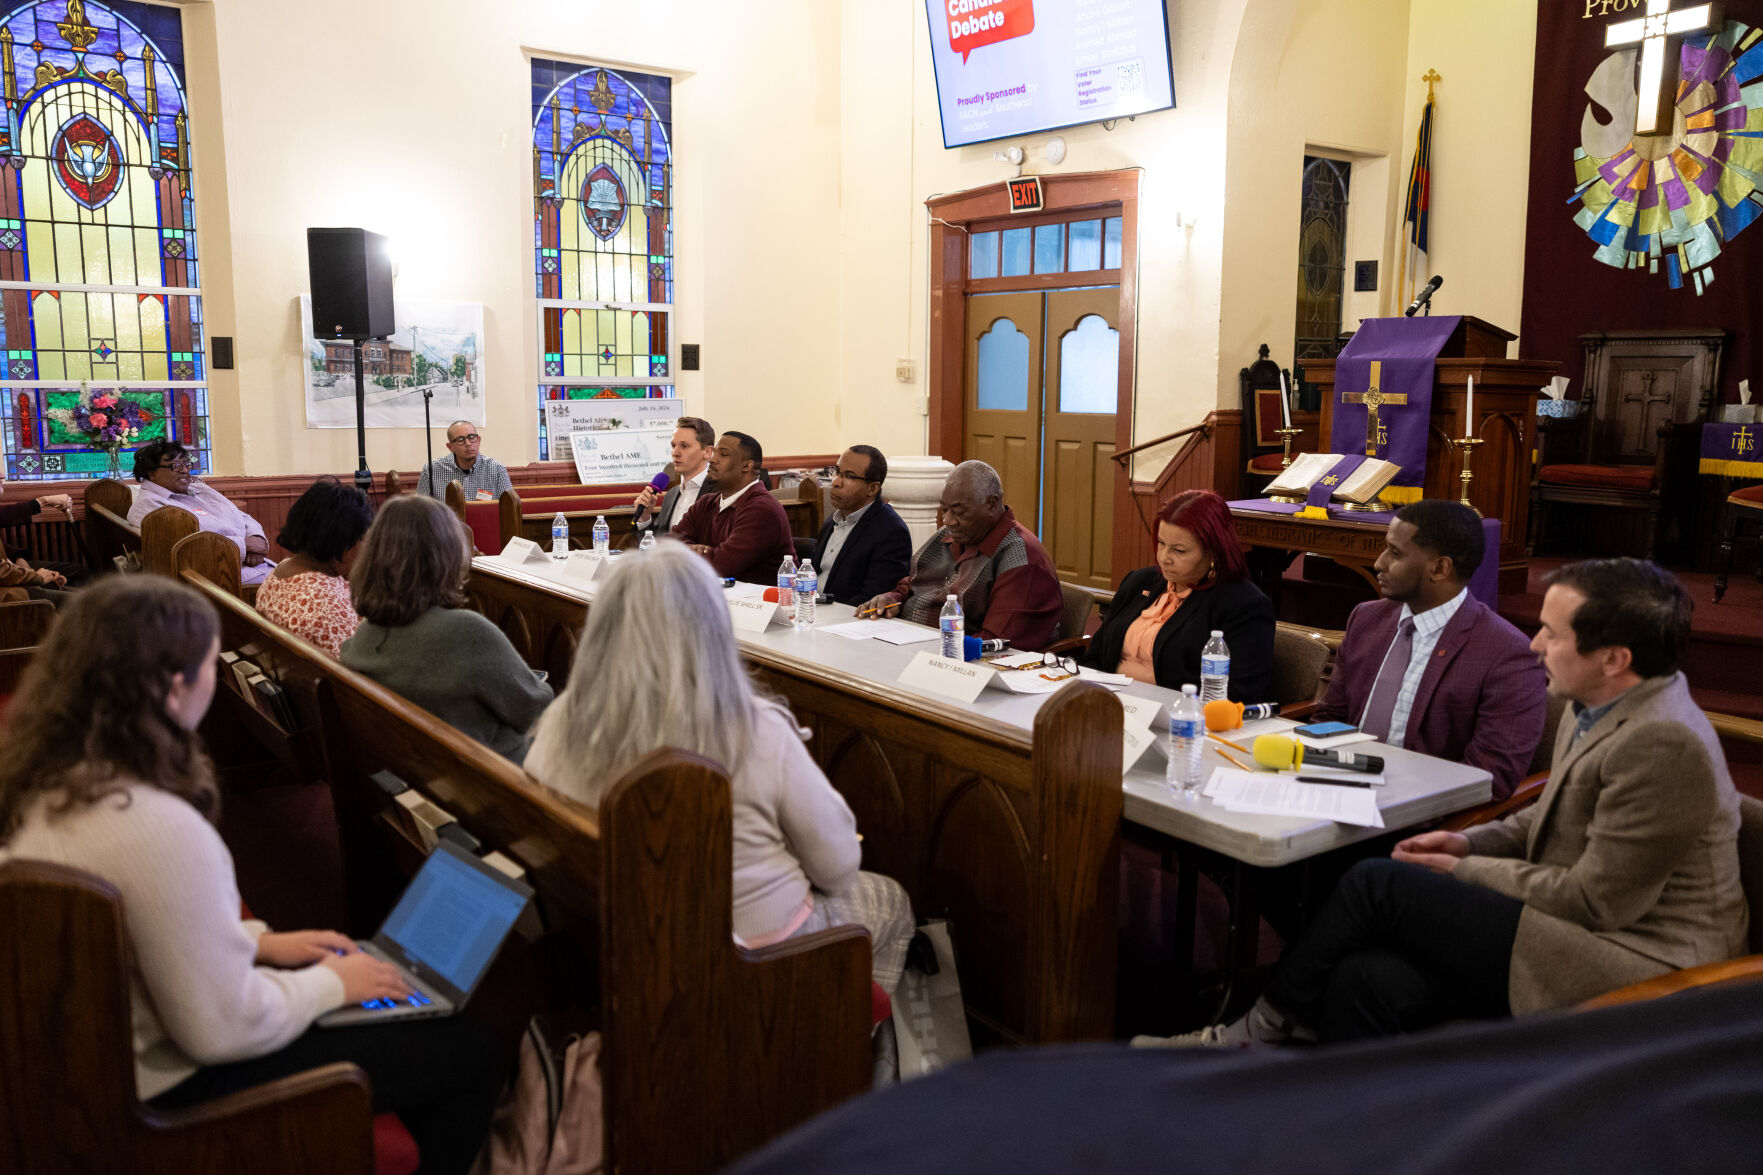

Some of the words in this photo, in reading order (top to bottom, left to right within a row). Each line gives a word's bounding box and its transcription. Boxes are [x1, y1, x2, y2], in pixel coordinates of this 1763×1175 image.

[1582, 0, 1648, 18] Prov
[950, 10, 1005, 39] Debate
[957, 93, 985, 107] Proudly
[985, 83, 1026, 103] Sponsored
[1011, 182, 1037, 206] EXIT
[601, 453, 624, 461] Bethel
[928, 659, 949, 669] NANCY
[952, 666, 977, 677] MILLAN
